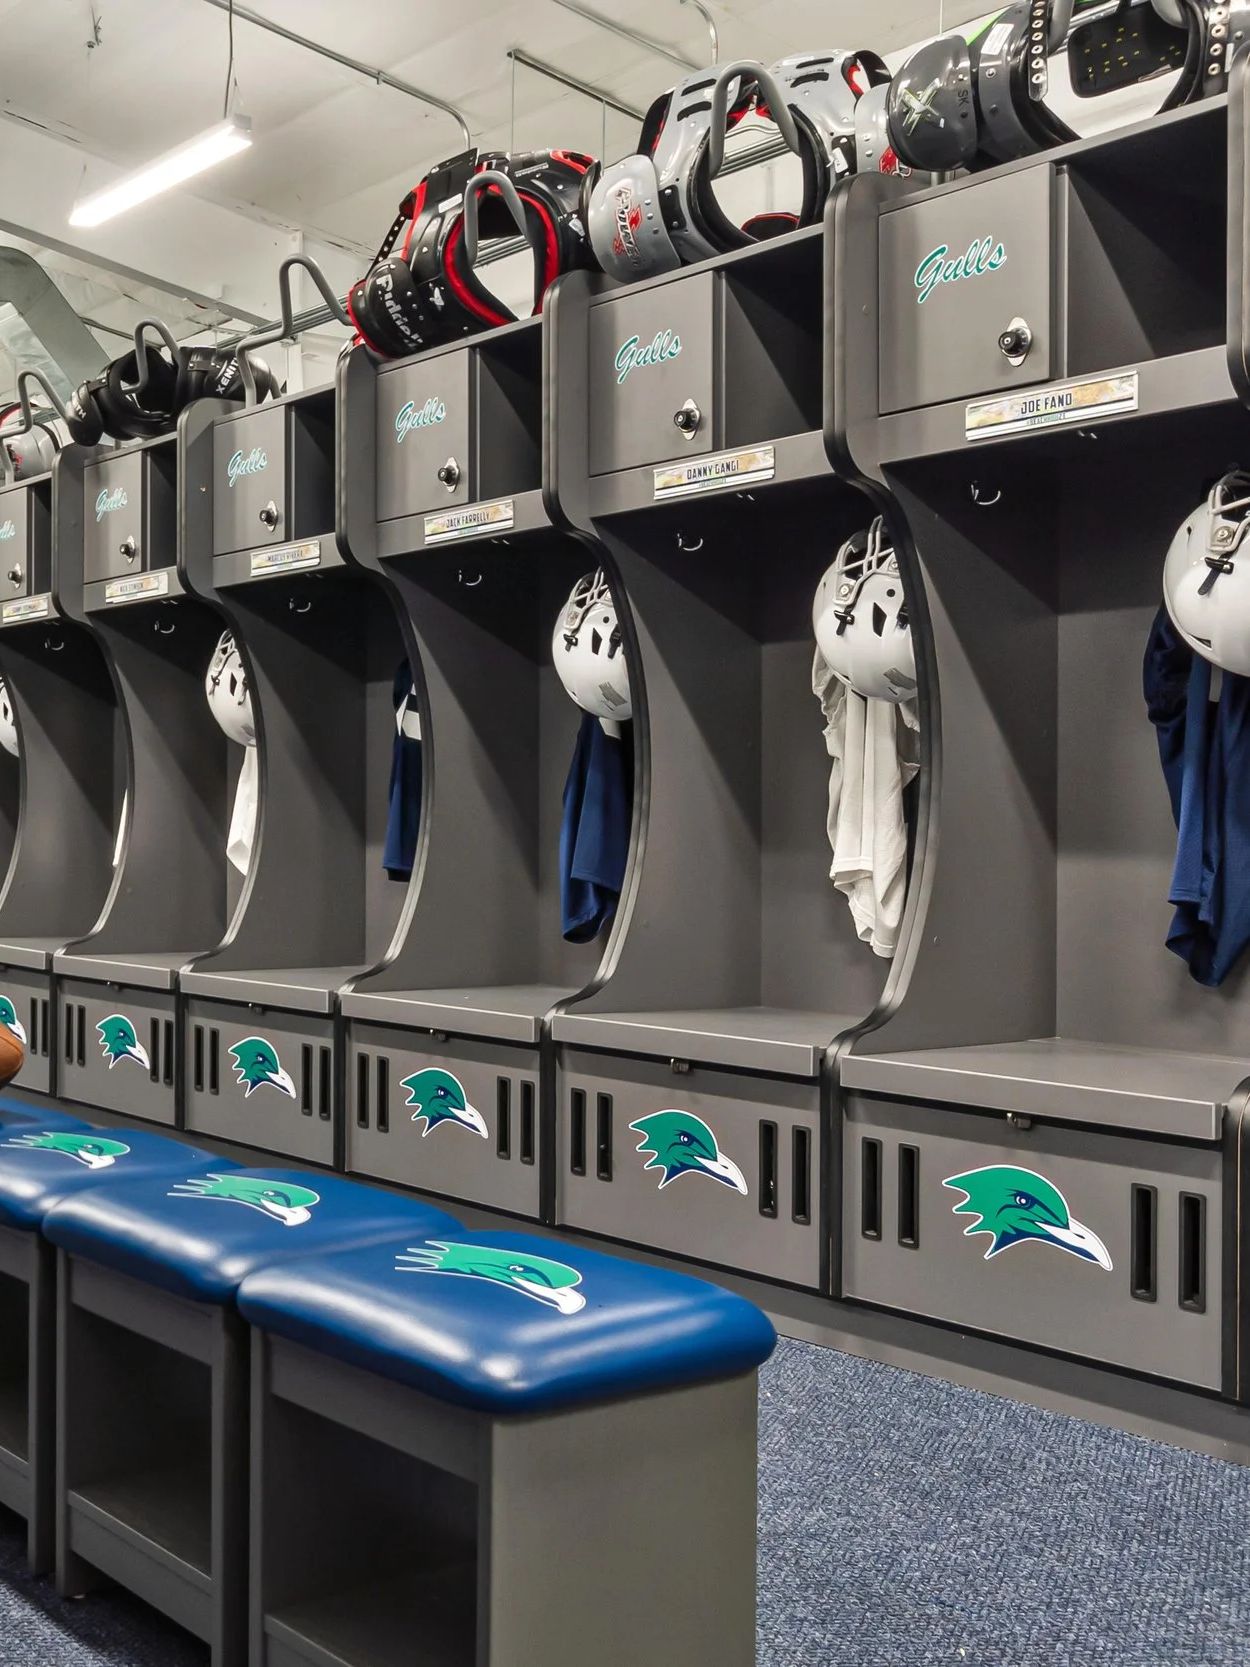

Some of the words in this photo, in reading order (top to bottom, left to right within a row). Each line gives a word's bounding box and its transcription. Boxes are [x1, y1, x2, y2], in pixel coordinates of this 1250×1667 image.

[913, 235, 1007, 304] Gulls
[215, 356, 239, 395] XENIT
[614, 328, 683, 385] Gulls
[394, 396, 447, 444] Gulls
[1021, 400, 1041, 415] JOE
[227, 448, 268, 487] Gulls
[686, 464, 713, 480] DANNY
[95, 487, 128, 522] Gulls
